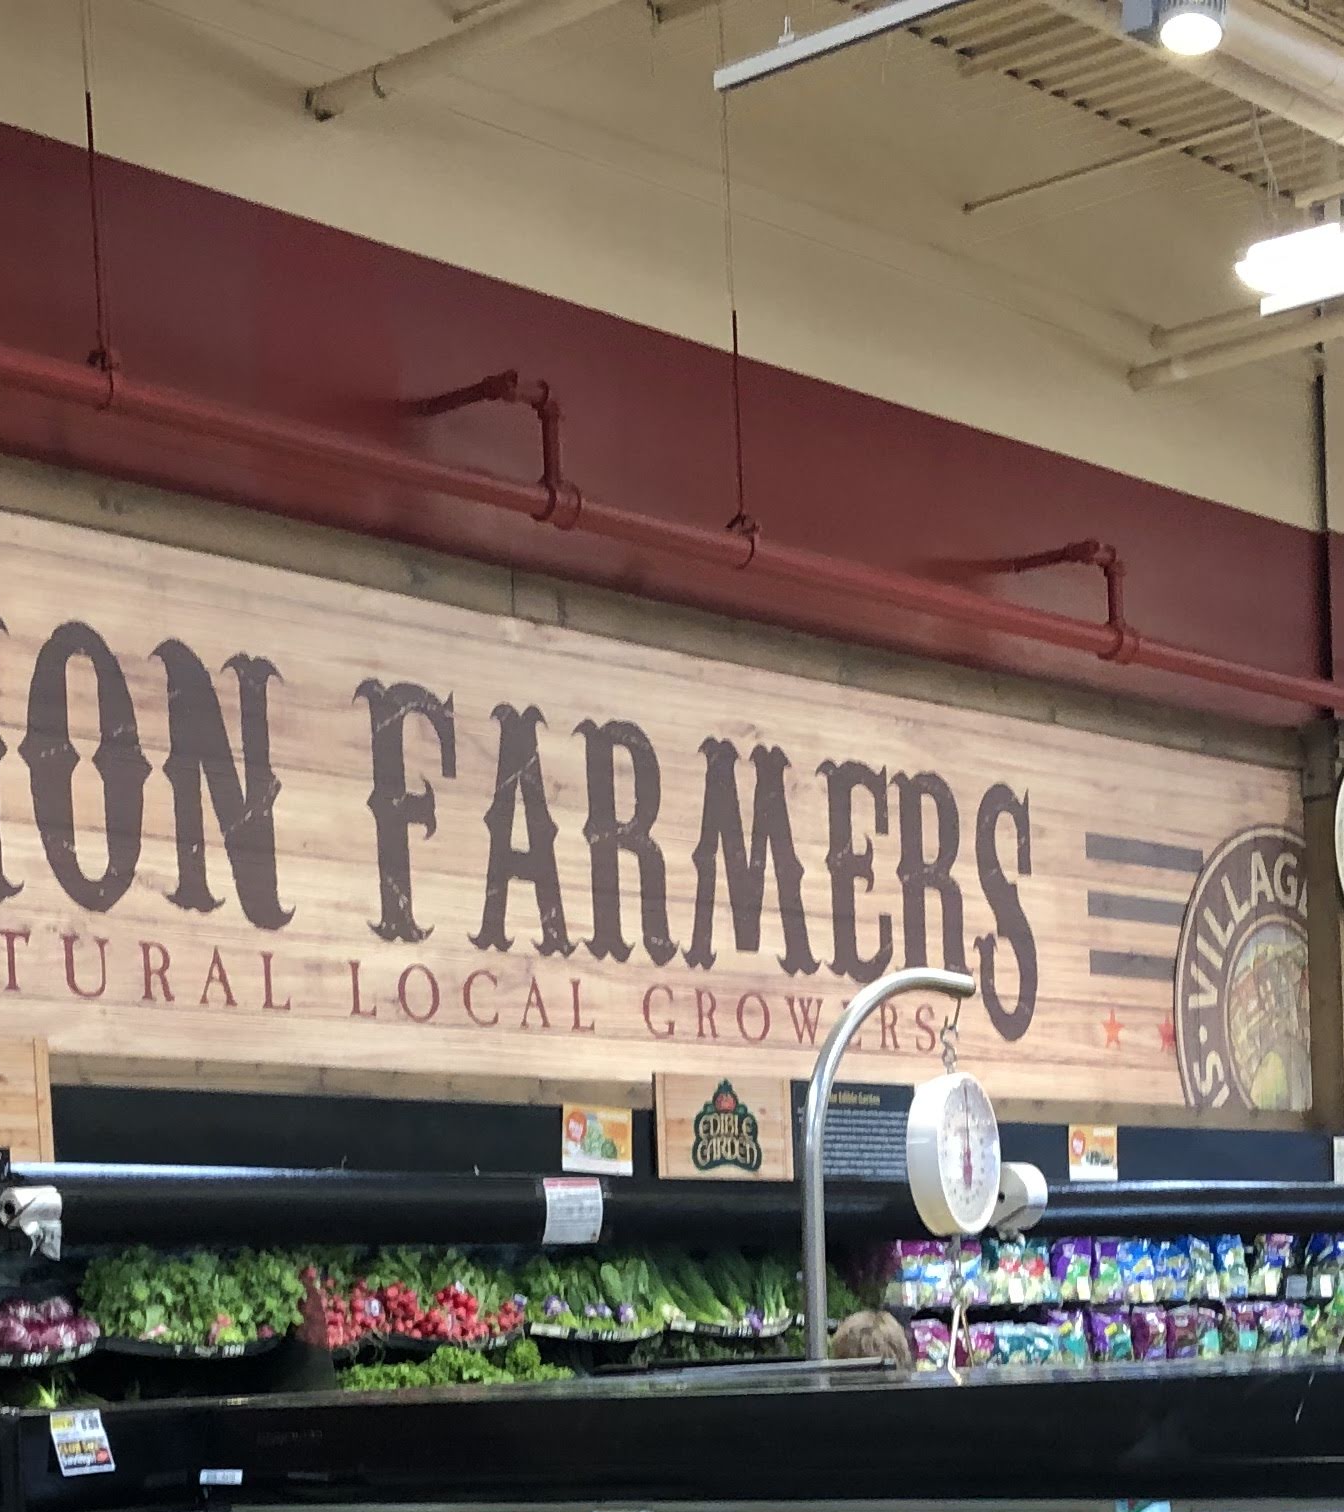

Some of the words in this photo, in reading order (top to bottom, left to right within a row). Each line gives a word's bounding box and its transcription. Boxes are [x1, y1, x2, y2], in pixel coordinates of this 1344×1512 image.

[352, 677, 1039, 1043] FARMERS
[349, 959, 596, 1033] LOCAL
[642, 983, 937, 1054] GROWRS
[697, 1136, 758, 1168] GARDEN
[698, 1112, 753, 1137] EDIBLE
